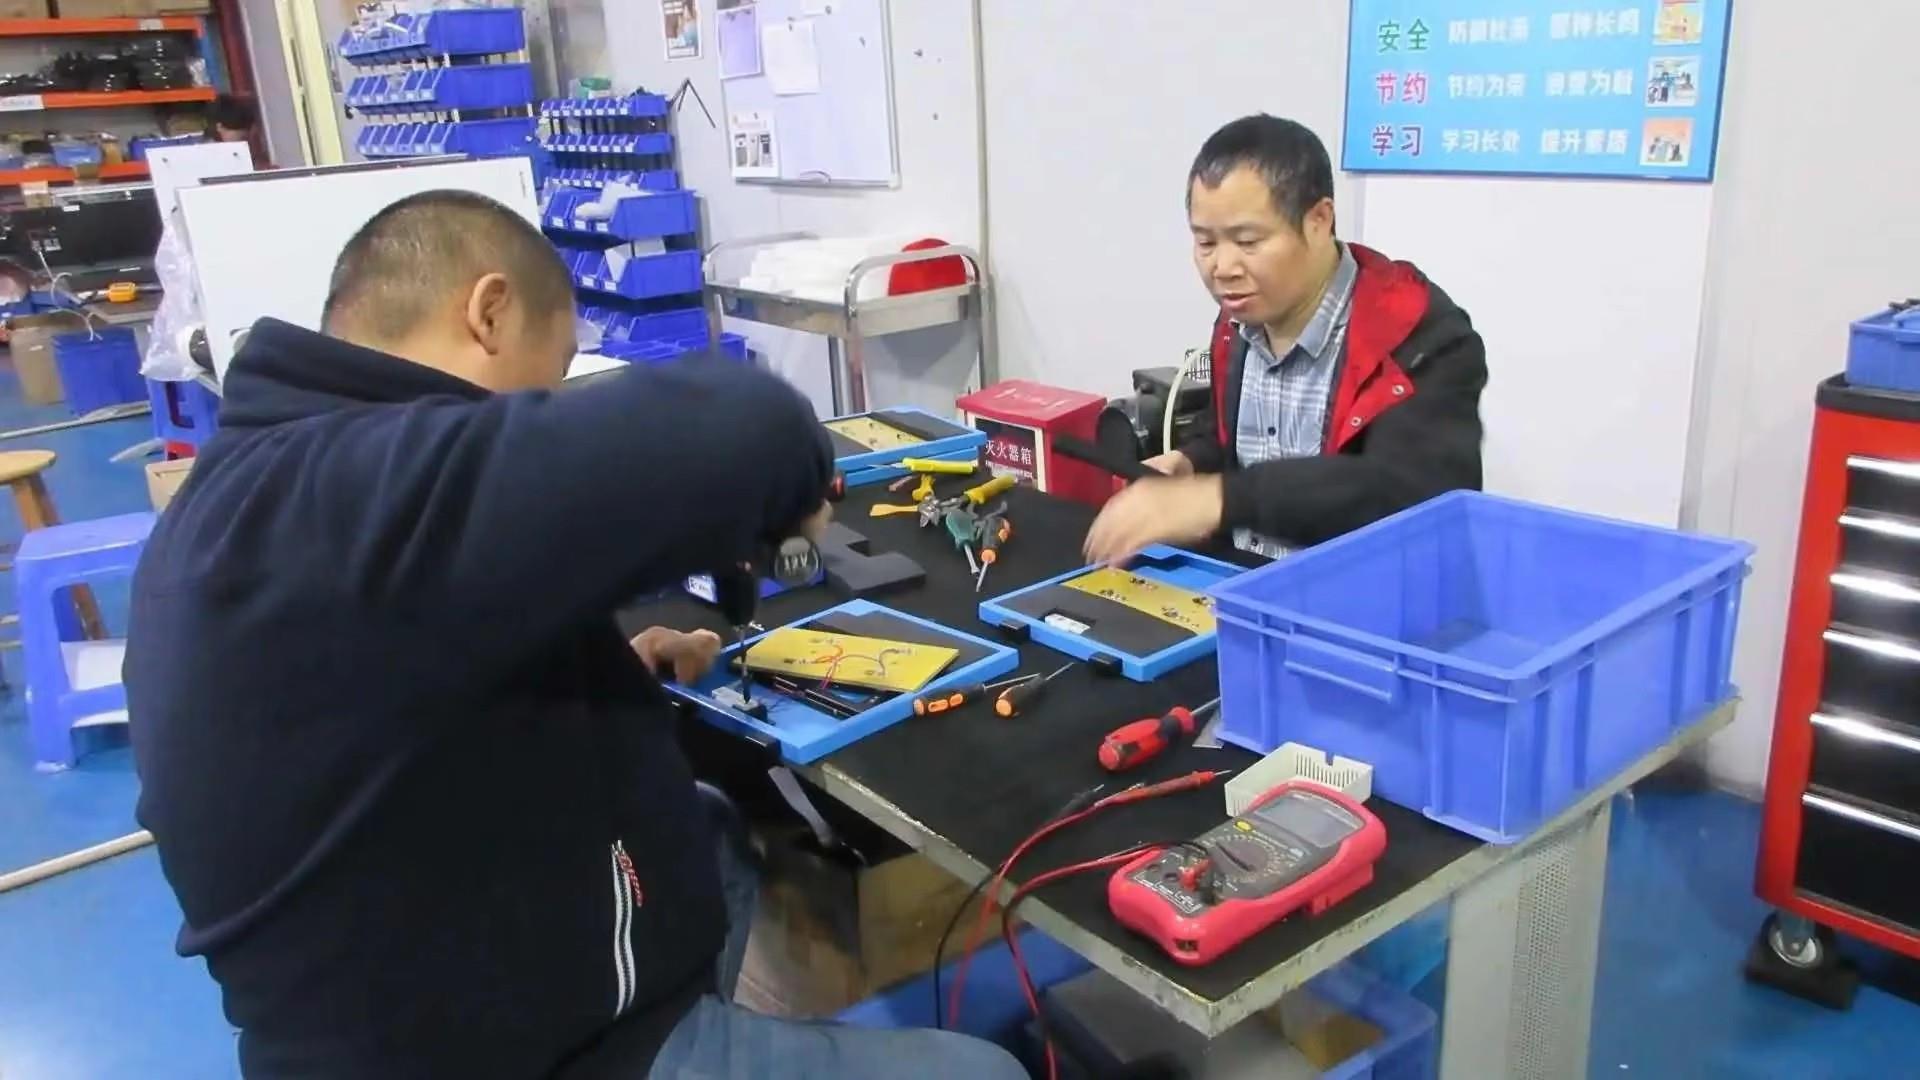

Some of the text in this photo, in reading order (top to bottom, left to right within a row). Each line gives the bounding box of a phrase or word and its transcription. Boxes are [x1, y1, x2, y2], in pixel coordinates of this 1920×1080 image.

[1378, 17, 1430, 53] 安全
[1375, 71, 1427, 105] 节约
[1448, 72, 1526, 98] 节约为荣
[1372, 125, 1422, 156] 学习
[1441, 127, 1520, 153] 学习长处
[985, 440, 1033, 465] 灭火器箱
